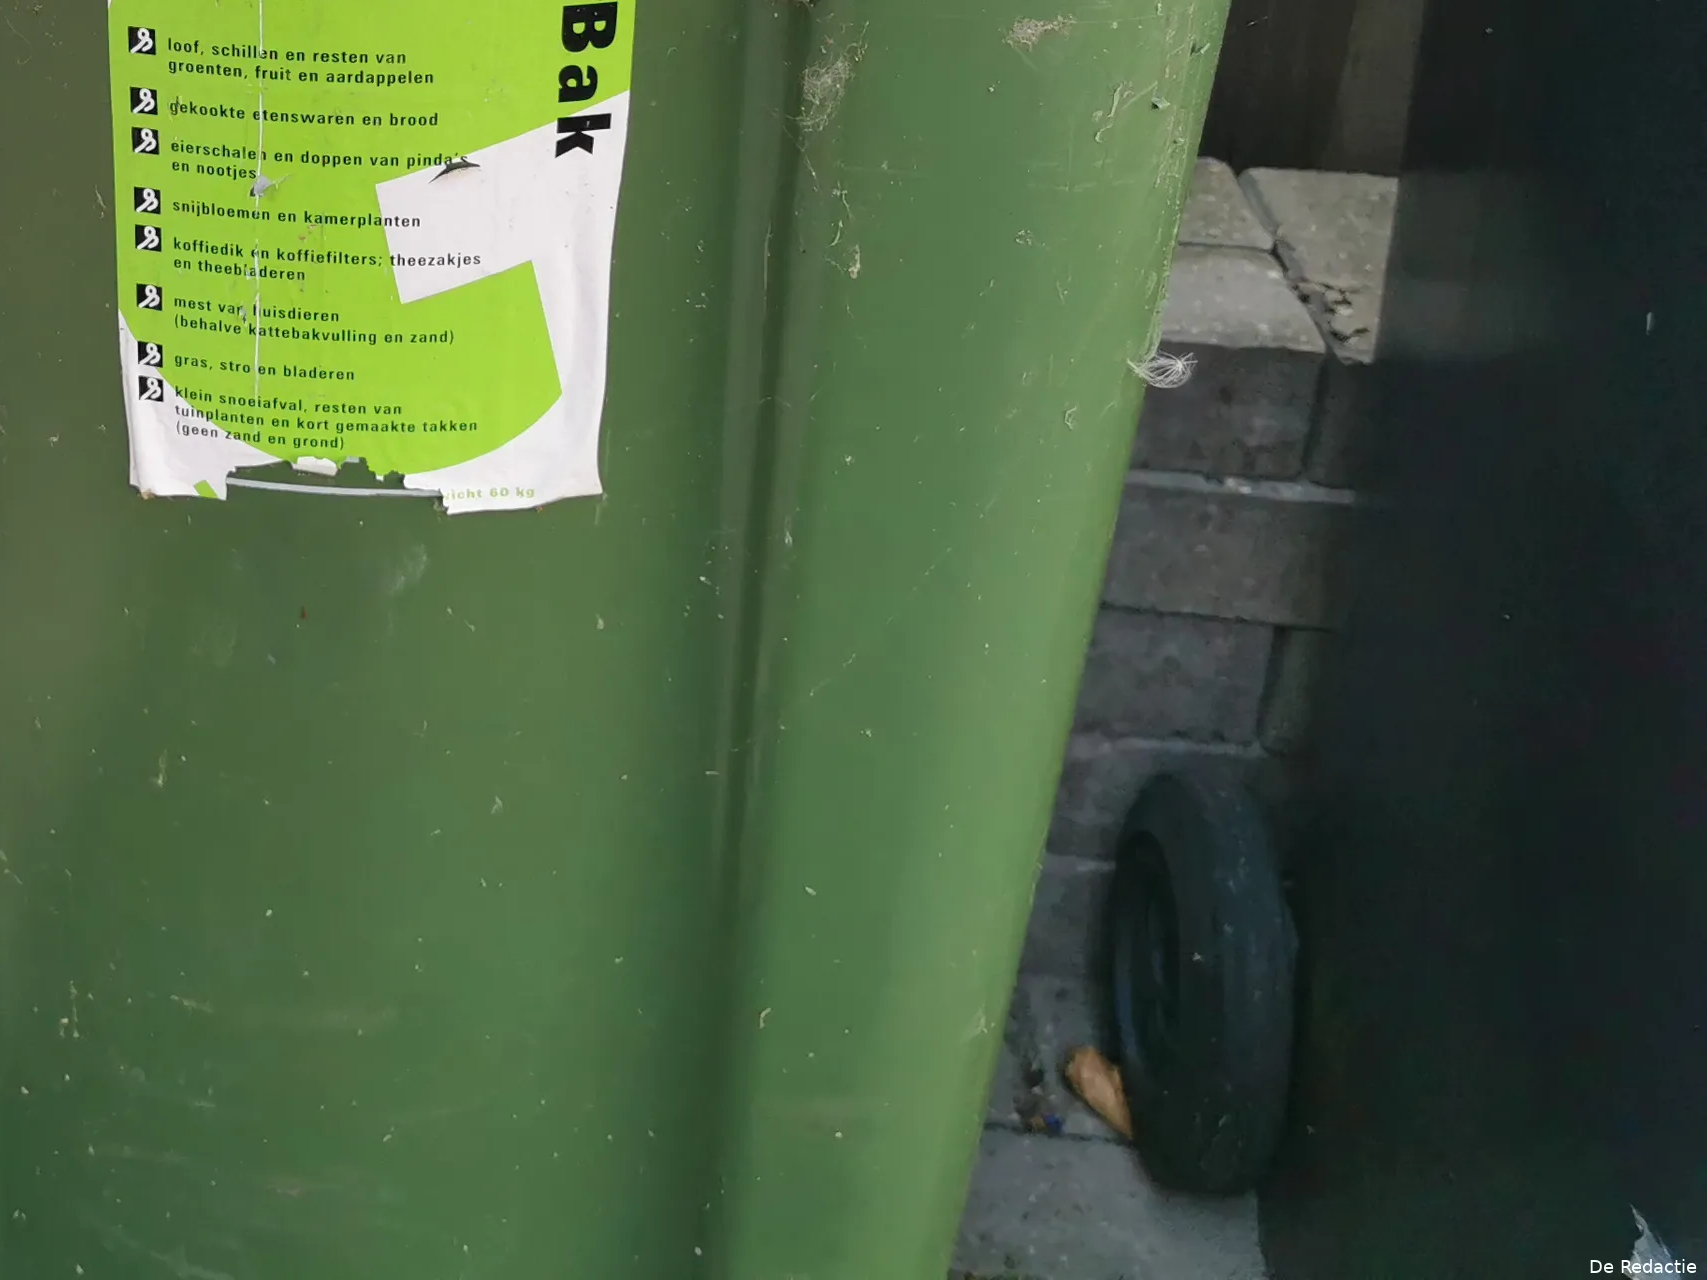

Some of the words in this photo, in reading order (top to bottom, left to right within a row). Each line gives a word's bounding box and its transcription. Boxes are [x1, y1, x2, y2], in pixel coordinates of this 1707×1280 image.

[168, 37, 204, 56] loof,
[211, 43, 278, 60] schillen
[285, 51, 305, 62] en
[313, 51, 368, 63] resten
[375, 53, 406, 64] van
[168, 61, 248, 79] groenten,
[255, 65, 292, 80] fruit
[298, 71, 318, 82] en
[326, 70, 434, 87] aardappelen
[170, 101, 245, 119] gekookte
[253, 109, 355, 125] etenswaren
[362, 115, 382, 126] en
[390, 112, 438, 126] brood
[171, 140, 266, 160] eierschalen
[274, 152, 293, 162] en
[301, 151, 362, 167] doppen
[370, 155, 399, 166] van
[172, 161, 189, 172] en
[197, 164, 257, 180] nootjes
[173, 200, 270, 220] snijbloemen
[278, 212, 296, 222] en
[304, 211, 421, 229] kamerplanten
[174, 237, 243, 257] koffiedik
[251, 247, 269, 260] en
[277, 248, 383, 267] koffiefilters;
[390, 252, 481, 268] theezakjes
[174, 258, 191, 270] en
[198, 260, 305, 280] theebladeren
[174, 297, 211, 311] mest
[174, 314, 241, 334] (behalve
[249, 323, 377, 346] kattebakvulling
[384, 334, 403, 343] en
[410, 330, 454, 345] zand)
[174, 355, 213, 370] gras,
[220, 361, 250, 374] stro
[258, 365, 276, 375] en
[283, 365, 355, 380] bladeren
[175, 386, 212, 402] klein
[219, 394, 307, 413] snoeiafval,
[315, 402, 367, 414] resten
[374, 406, 402, 415] van
[175, 405, 264, 425] tuinplanten
[271, 418, 289, 428] en
[297, 417, 329, 431] kort
[336, 421, 415, 433] gemaakte
[423, 420, 477, 433] takken
[176, 421, 218, 439] (geen
[225, 431, 261, 443] zand
[268, 435, 286, 445] en
[294, 437, 344, 450] grond)
[490, 487, 509, 498] 60
[516, 487, 535, 499] kg
